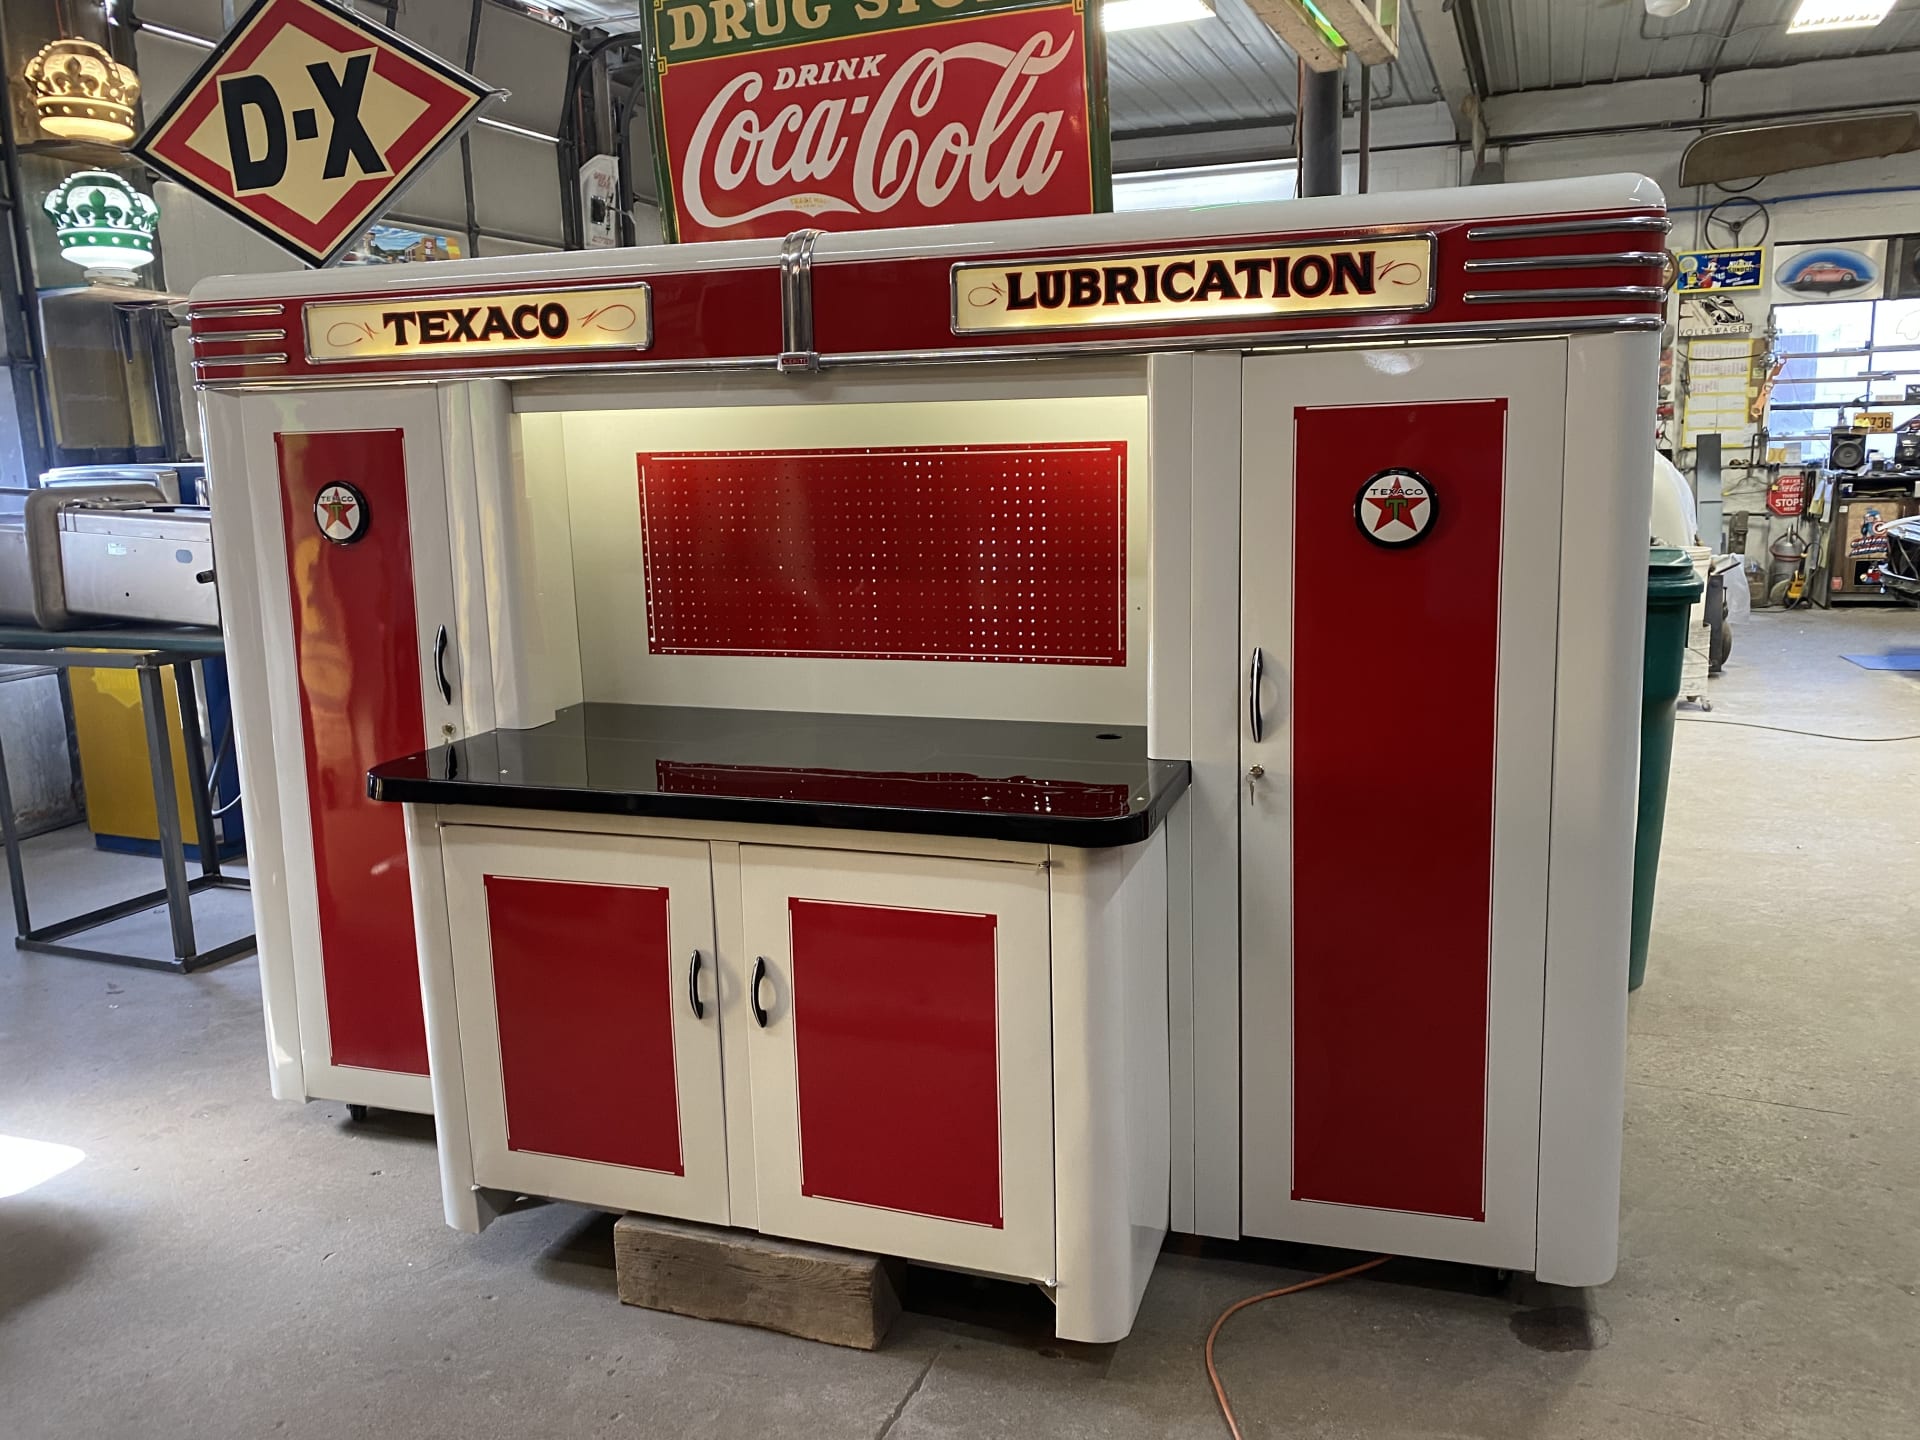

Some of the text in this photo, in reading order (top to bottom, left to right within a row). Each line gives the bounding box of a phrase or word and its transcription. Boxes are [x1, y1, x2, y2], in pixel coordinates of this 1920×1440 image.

[667, 0, 831, 51] DRUG
[773, 53, 887, 92] DRINK
[220, 54, 387, 191] D-X
[682, 29, 1075, 228] Coca-Cola
[1005, 250, 1377, 312] LUBRICATION
[382, 302, 569, 346] TEXACO
[1680, 324, 1752, 337] VOLKSWAGEN
[1370, 488, 1424, 496] TEXACO
